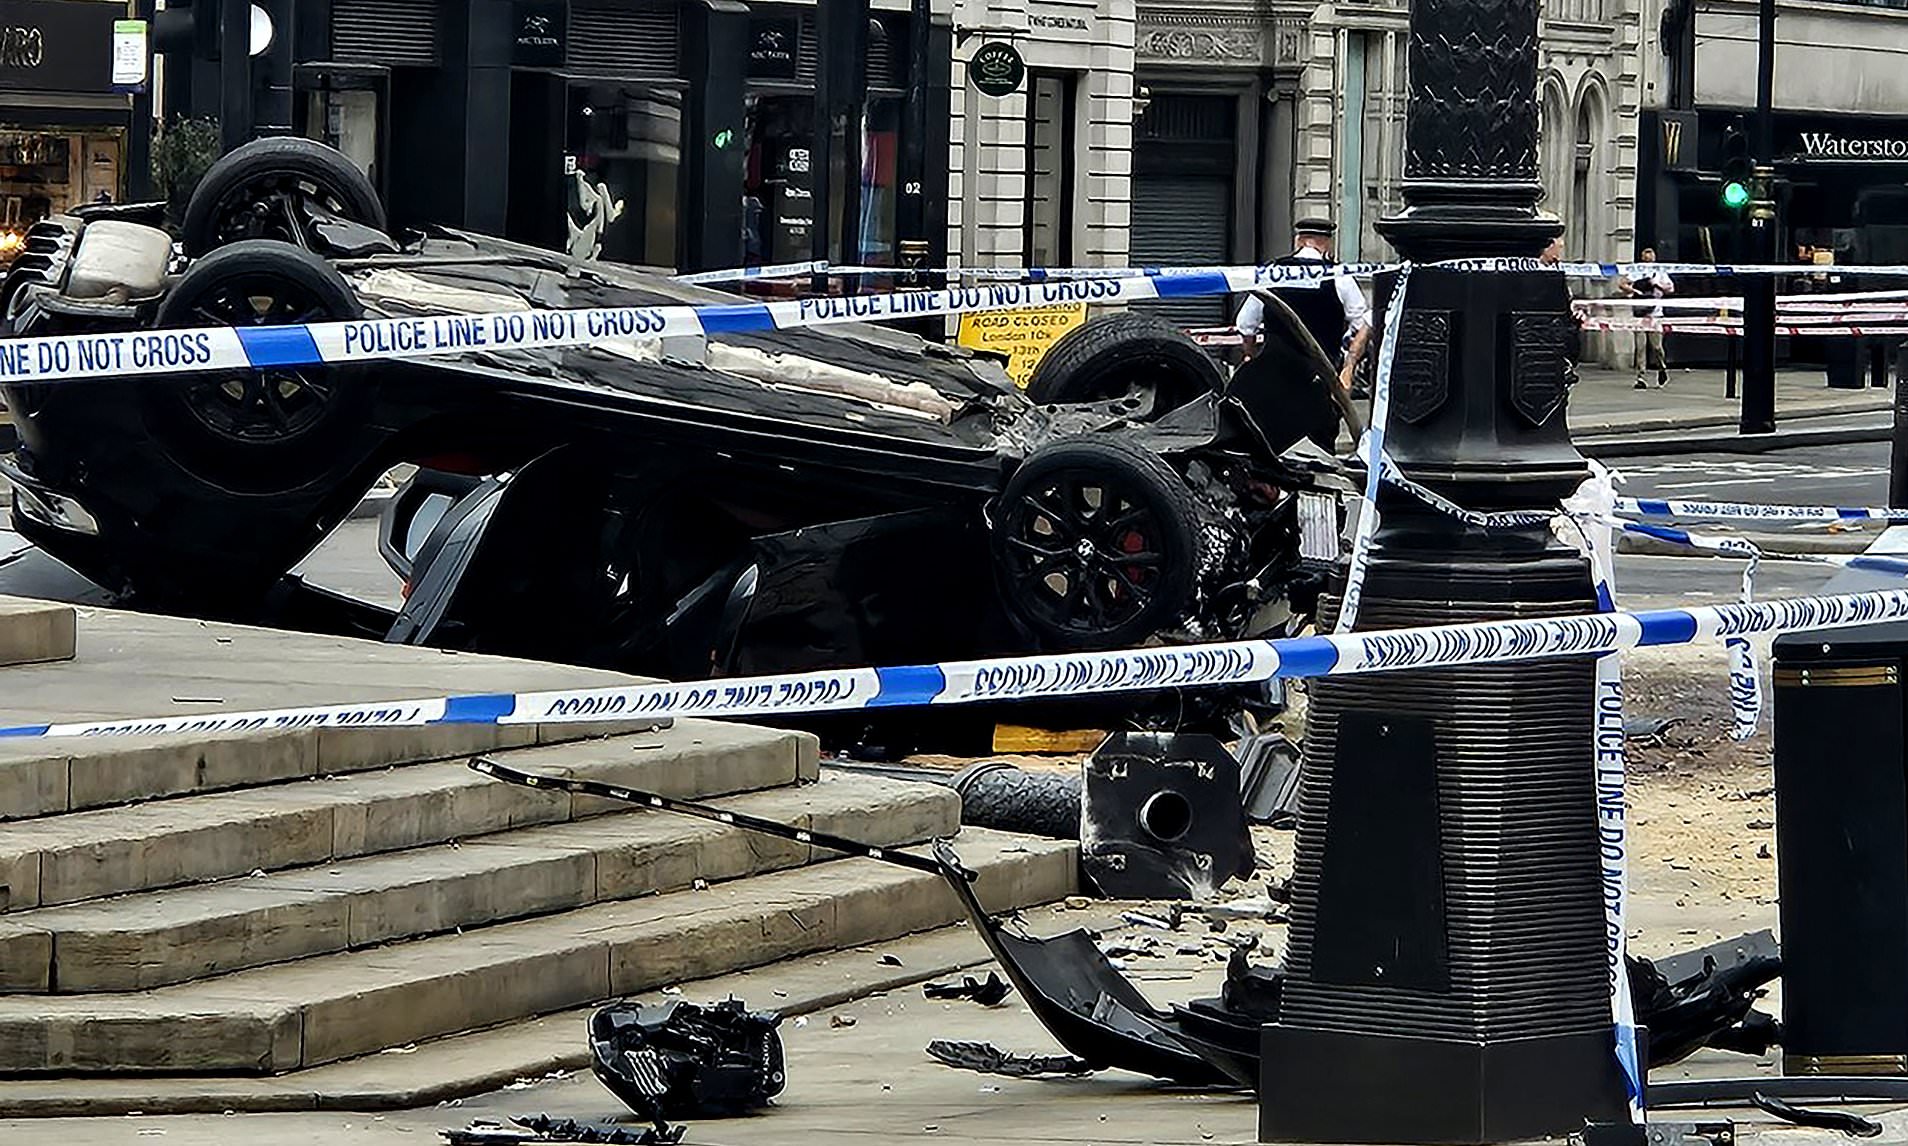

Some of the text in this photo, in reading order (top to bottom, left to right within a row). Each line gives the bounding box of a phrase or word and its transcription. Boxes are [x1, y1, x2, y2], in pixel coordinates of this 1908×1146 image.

[905, 182, 921, 194] 02
[800, 299, 882, 321] POLICE
[890, 293, 942, 313] LINE
[949, 287, 981, 309] DO
[989, 284, 1031, 306] NOT
[1041, 281, 1122, 302] CROSS
[344, 309, 667, 354] POLICE LINE DO NOT CROSS
[971, 315, 1069, 328] ROAD CLOSED
[982, 332, 1026, 342] London
[39, 341, 70, 374] DO
[78, 337, 124, 372] NOT
[132, 332, 212, 369] CROSS
[1714, 602, 1777, 637] CROSS
[1777, 598, 1815, 630] NOT
[1814, 594, 1845, 626] DO
[1845, 590, 1887, 622] LINE
[1358, 616, 1618, 669] POLICE LINE DO NOT CROSS
[1087, 657, 1128, 689] DO
[1122, 653, 1179, 685] LINE
[1174, 647, 1255, 682] POLICE
[1598, 682, 1625, 761] POLICE
[1598, 769, 1625, 820] LINE
[1599, 826, 1625, 861] DO
[1601, 868, 1623, 915] NOT
